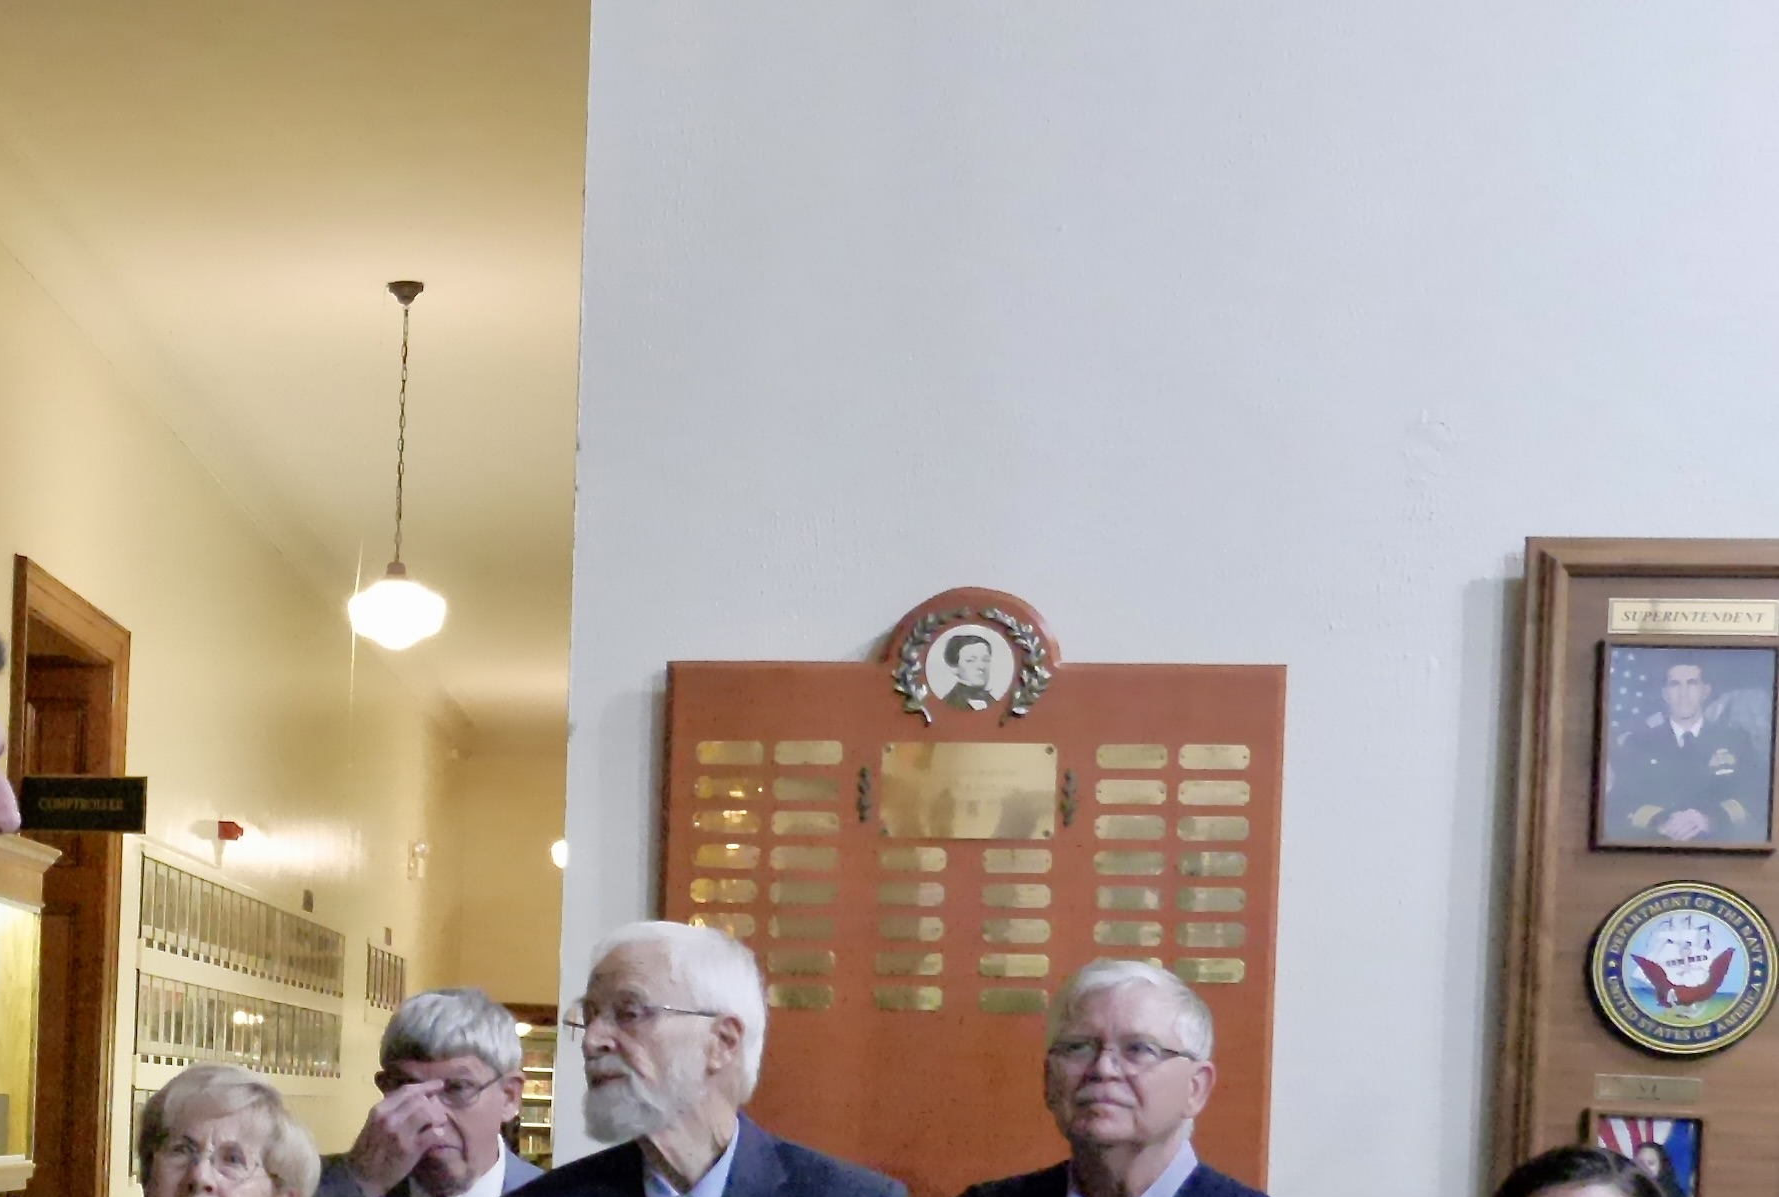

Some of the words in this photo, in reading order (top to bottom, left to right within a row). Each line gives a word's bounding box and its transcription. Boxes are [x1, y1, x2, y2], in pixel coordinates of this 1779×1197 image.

[1622, 610, 1766, 624] SUPERINTENDENT
[1610, 896, 1691, 953] DEPARTMENT
[1694, 897, 1715, 909] OF
[1717, 906, 1745, 928] THE
[1741, 924, 1765, 964] NAVY
[1638, 1014, 1691, 1041] STATES
